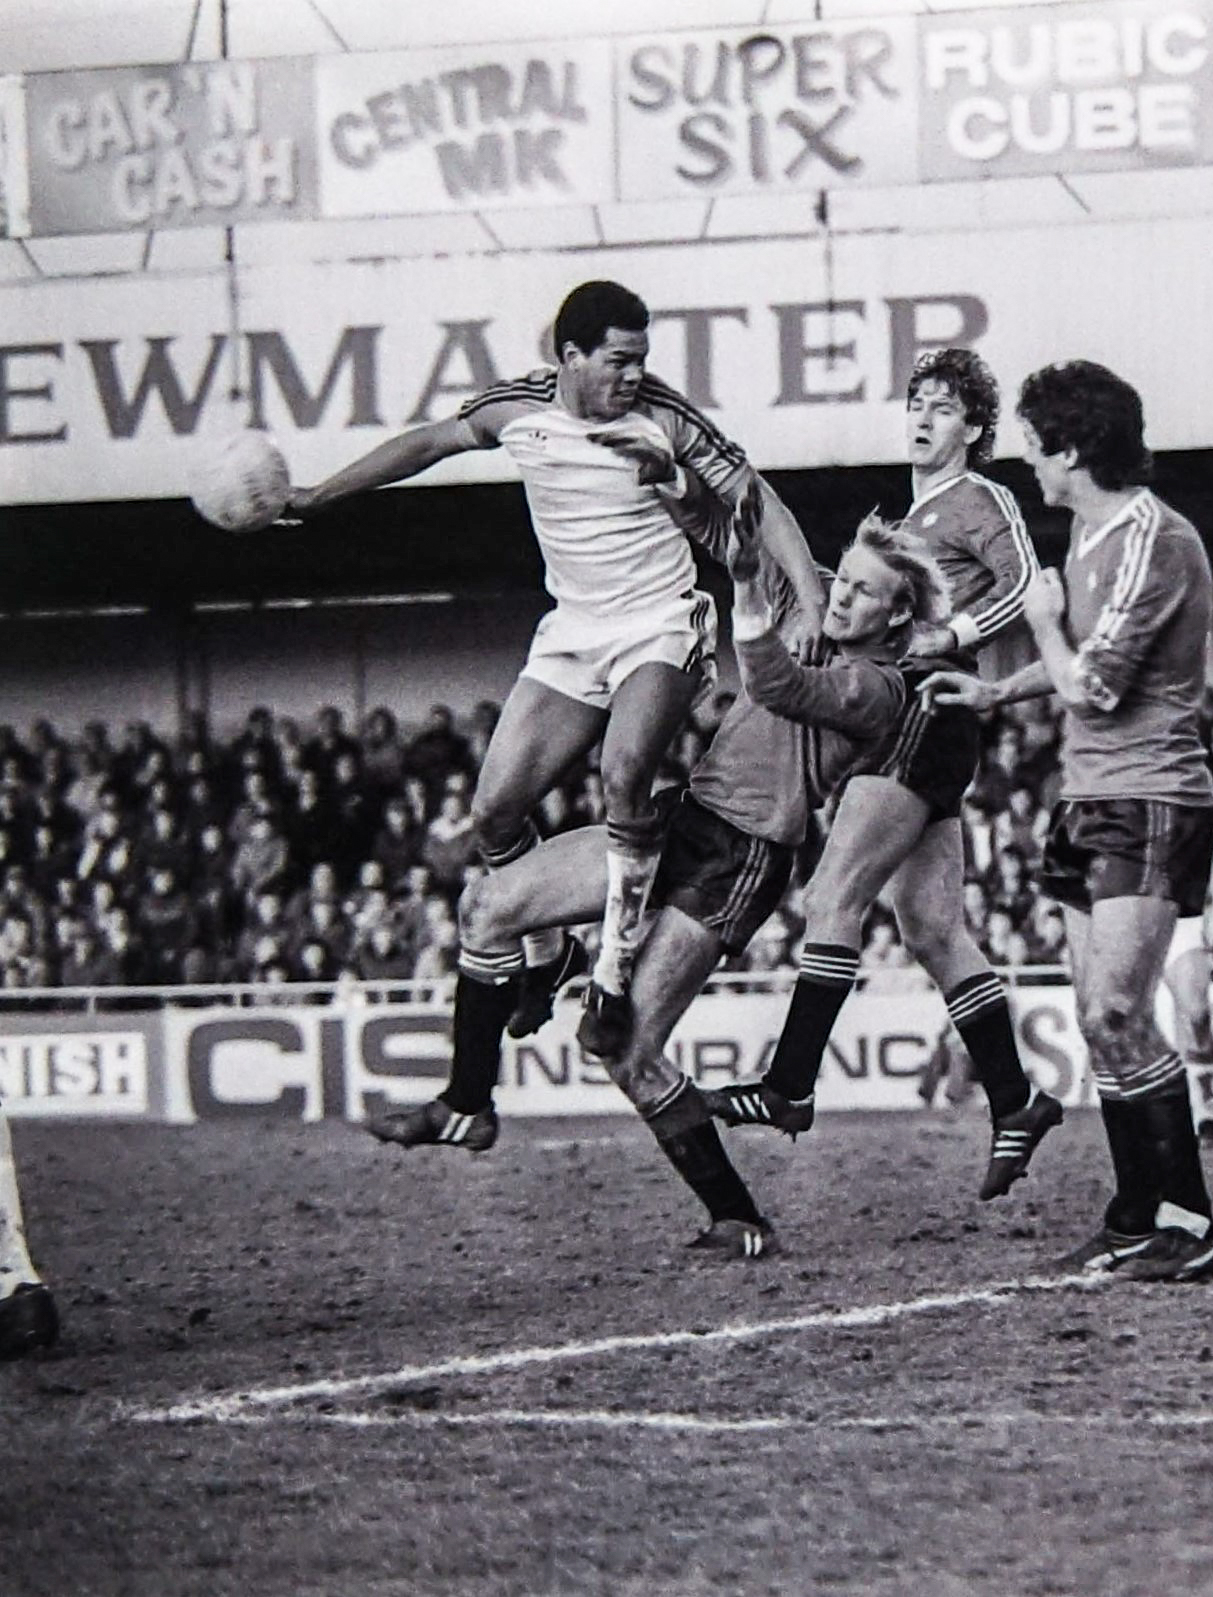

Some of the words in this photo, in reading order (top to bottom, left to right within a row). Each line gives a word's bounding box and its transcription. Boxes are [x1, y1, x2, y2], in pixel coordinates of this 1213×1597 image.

[628, 31, 898, 112] SUPER
[925, 15, 1208, 89] RUBIC
[48, 77, 182, 170] CAR
[330, 59, 588, 169] CENTRAL
[675, 103, 863, 186] SIX
[947, 84, 1196, 160] CUBE
[112, 138, 297, 222] CASH
[434, 128, 574, 200] MK
[0, 293, 989, 444] EWMATER
